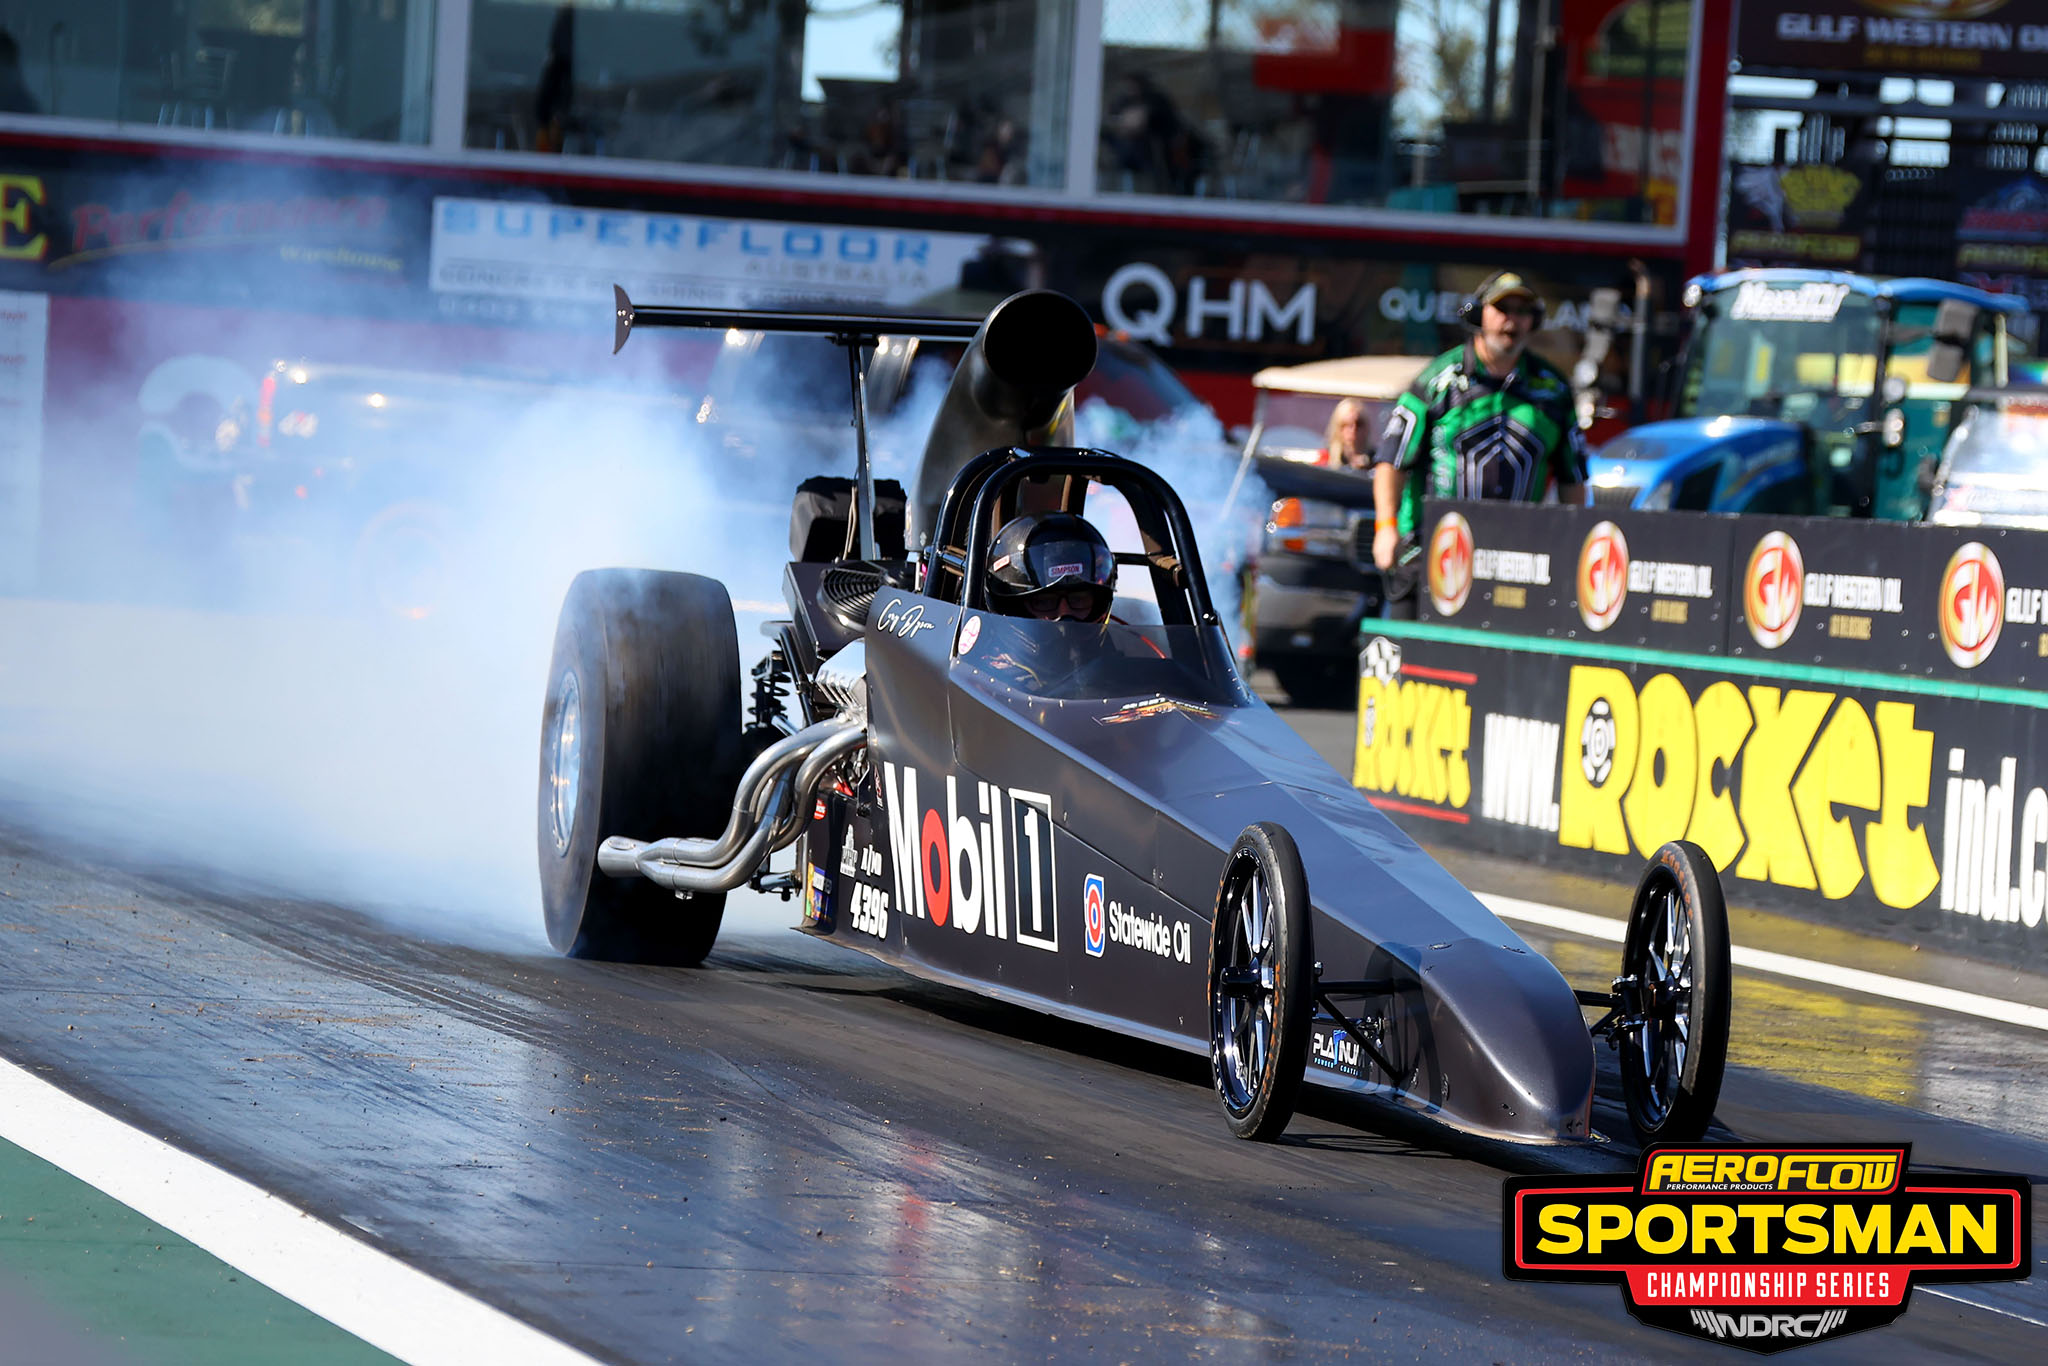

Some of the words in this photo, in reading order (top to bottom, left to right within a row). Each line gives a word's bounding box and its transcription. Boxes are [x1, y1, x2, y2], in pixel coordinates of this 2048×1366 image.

[1777, 13, 1859, 43] GULF
[1863, 17, 2013, 50] WESTERN
[443, 202, 931, 266] SUPERFLOOR
[1102, 262, 1316, 347] QHM
[1051, 566, 1081, 574] SIMPSON
[1804, 573, 1834, 607] GULF
[1831, 574, 1883, 612] WESTERN
[2005, 586, 2042, 625] GULF
[883, 761, 1008, 940] Mobil
[850, 881, 889, 939] 4396
[1109, 900, 1172, 957] Statewide
[1173, 920, 1191, 964] Oil
